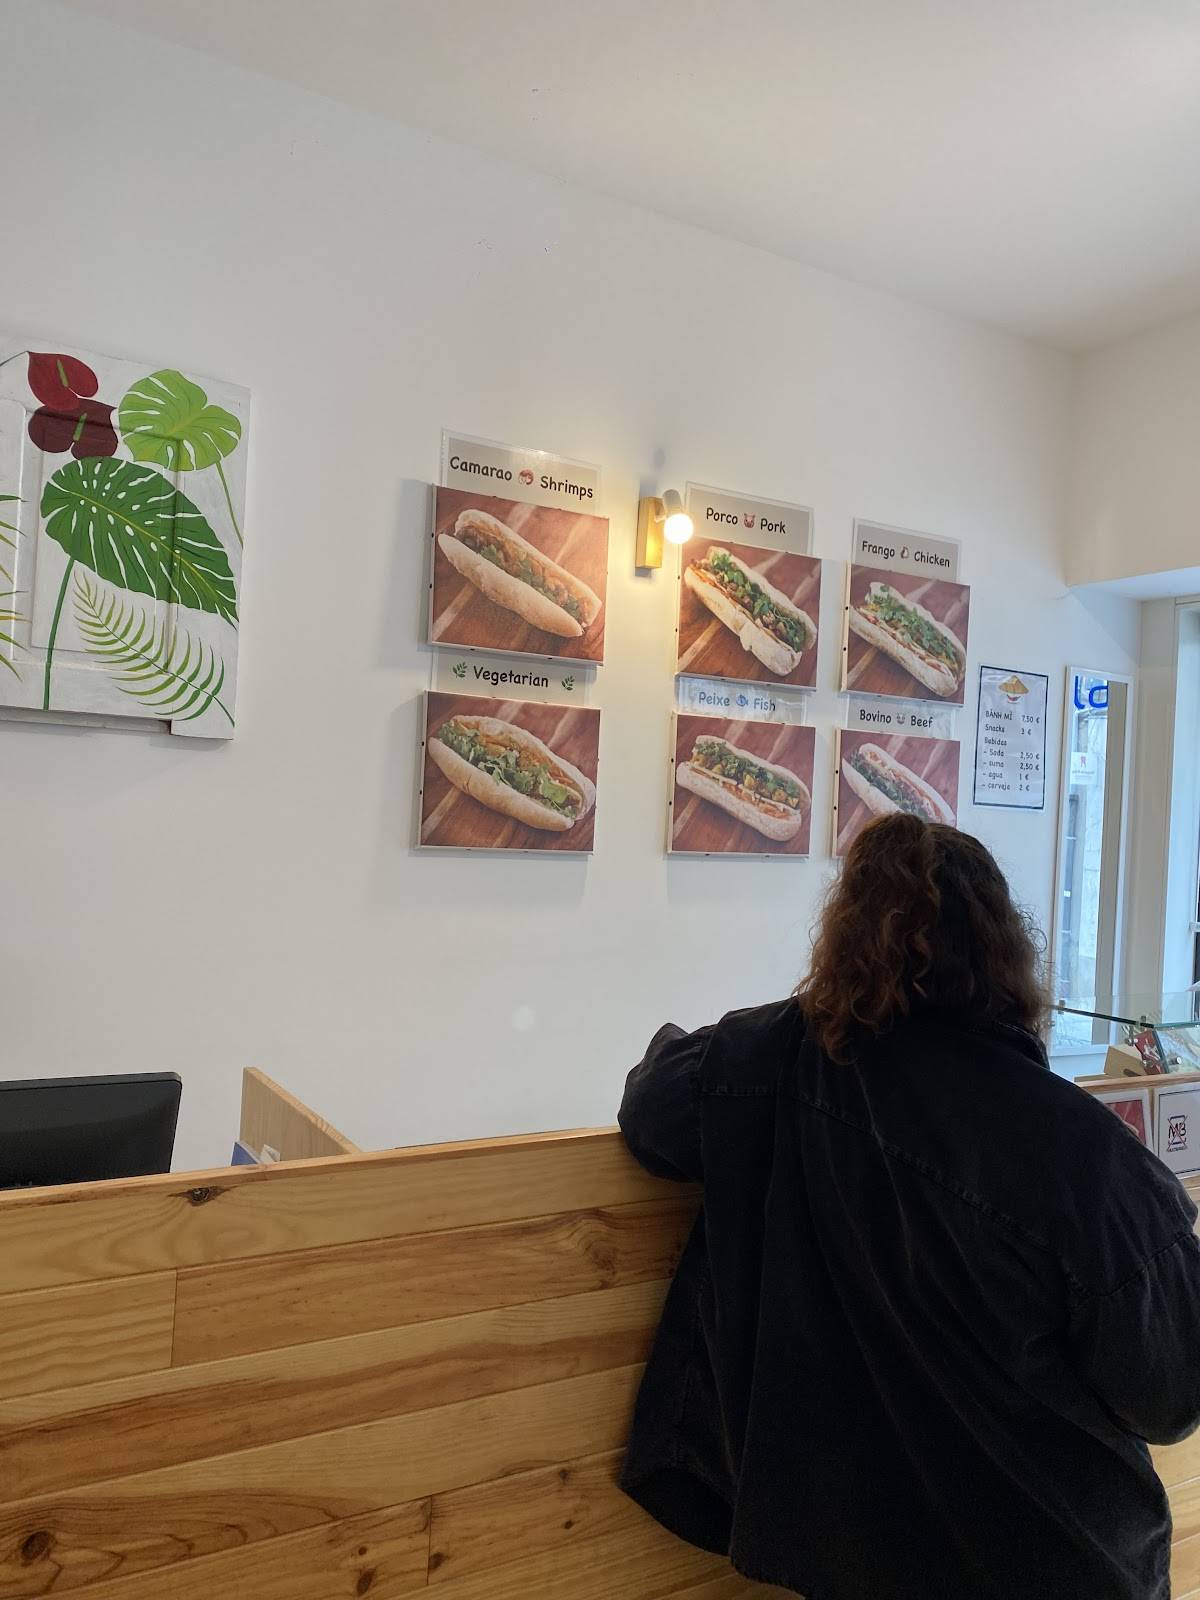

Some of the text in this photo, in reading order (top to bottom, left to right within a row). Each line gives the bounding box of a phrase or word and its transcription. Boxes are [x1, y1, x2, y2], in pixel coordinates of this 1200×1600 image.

[449, 456, 594, 501] Camarao Shrimps
[706, 507, 786, 534] Porco Pork
[862, 540, 950, 568] Frango Chicken
[473, 665, 549, 688] Vegetarian
[698, 691, 776, 712] Peixe Fish
[859, 709, 934, 729] Bovino Beef
[985, 723, 1005, 733] Snacks
[984, 736, 1007, 746] Bebidas
[1020, 762, 1033, 771] 2,50
